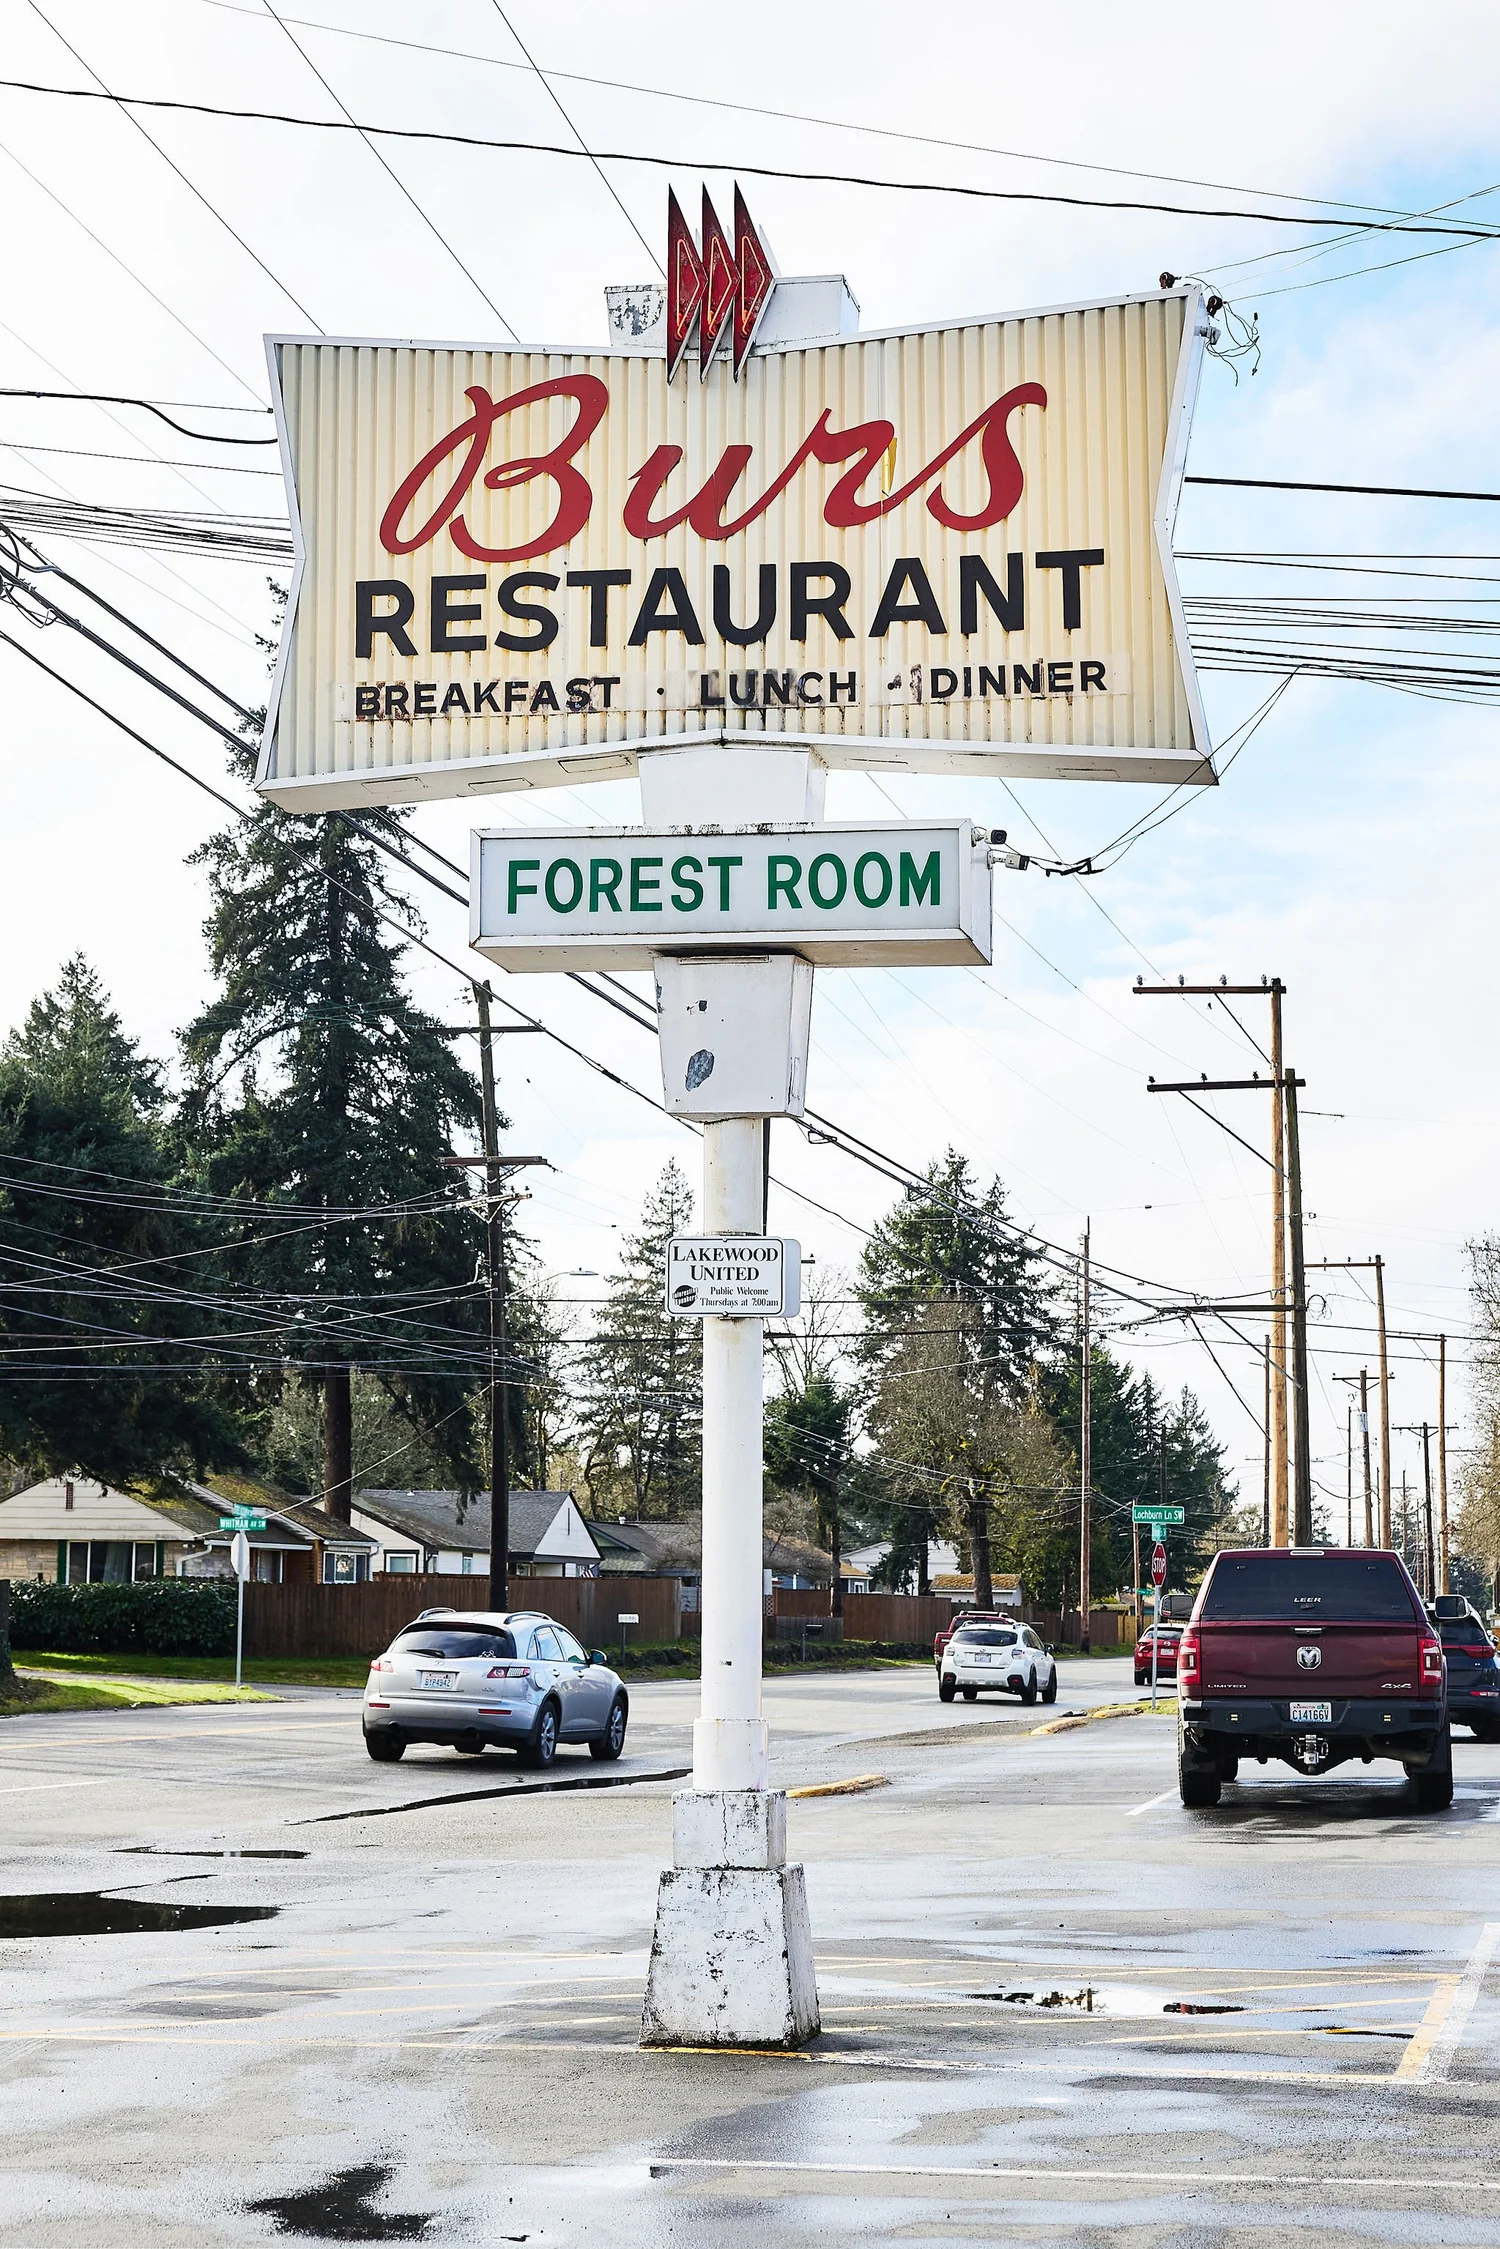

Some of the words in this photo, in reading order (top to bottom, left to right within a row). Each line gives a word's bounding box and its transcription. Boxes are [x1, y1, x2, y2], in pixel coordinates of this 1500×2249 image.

[381, 373, 1047, 563] Burs
[355, 548, 1105, 659] RESTAURANT
[355, 676, 621, 716] BREAKFAST
[700, 670, 857, 706] LUNCH
[930, 660, 1108, 699] DINNER
[507, 856, 743, 915] FOREST
[767, 851, 941, 910] ROOM
[672, 1245, 779, 1262] LAKEWOOD
[690, 1264, 760, 1281] UNITED
[710, 1286, 734, 1296] Public
[736, 1286, 769, 1296] Welcome
[699, 1297, 739, 1309] Thursdays
[740, 1298, 749, 1307] at
[1134, 1509, 1163, 1520] Lochburn
[1164, 1510, 1172, 1520] Ln
[1173, 1511, 1183, 1521] SW
[220, 1519, 249, 1529] WHITMAN
[258, 1520, 267, 1528] SW
[1152, 1557, 1166, 1574] STOP
[1292, 1709, 1329, 1721] C14166V
